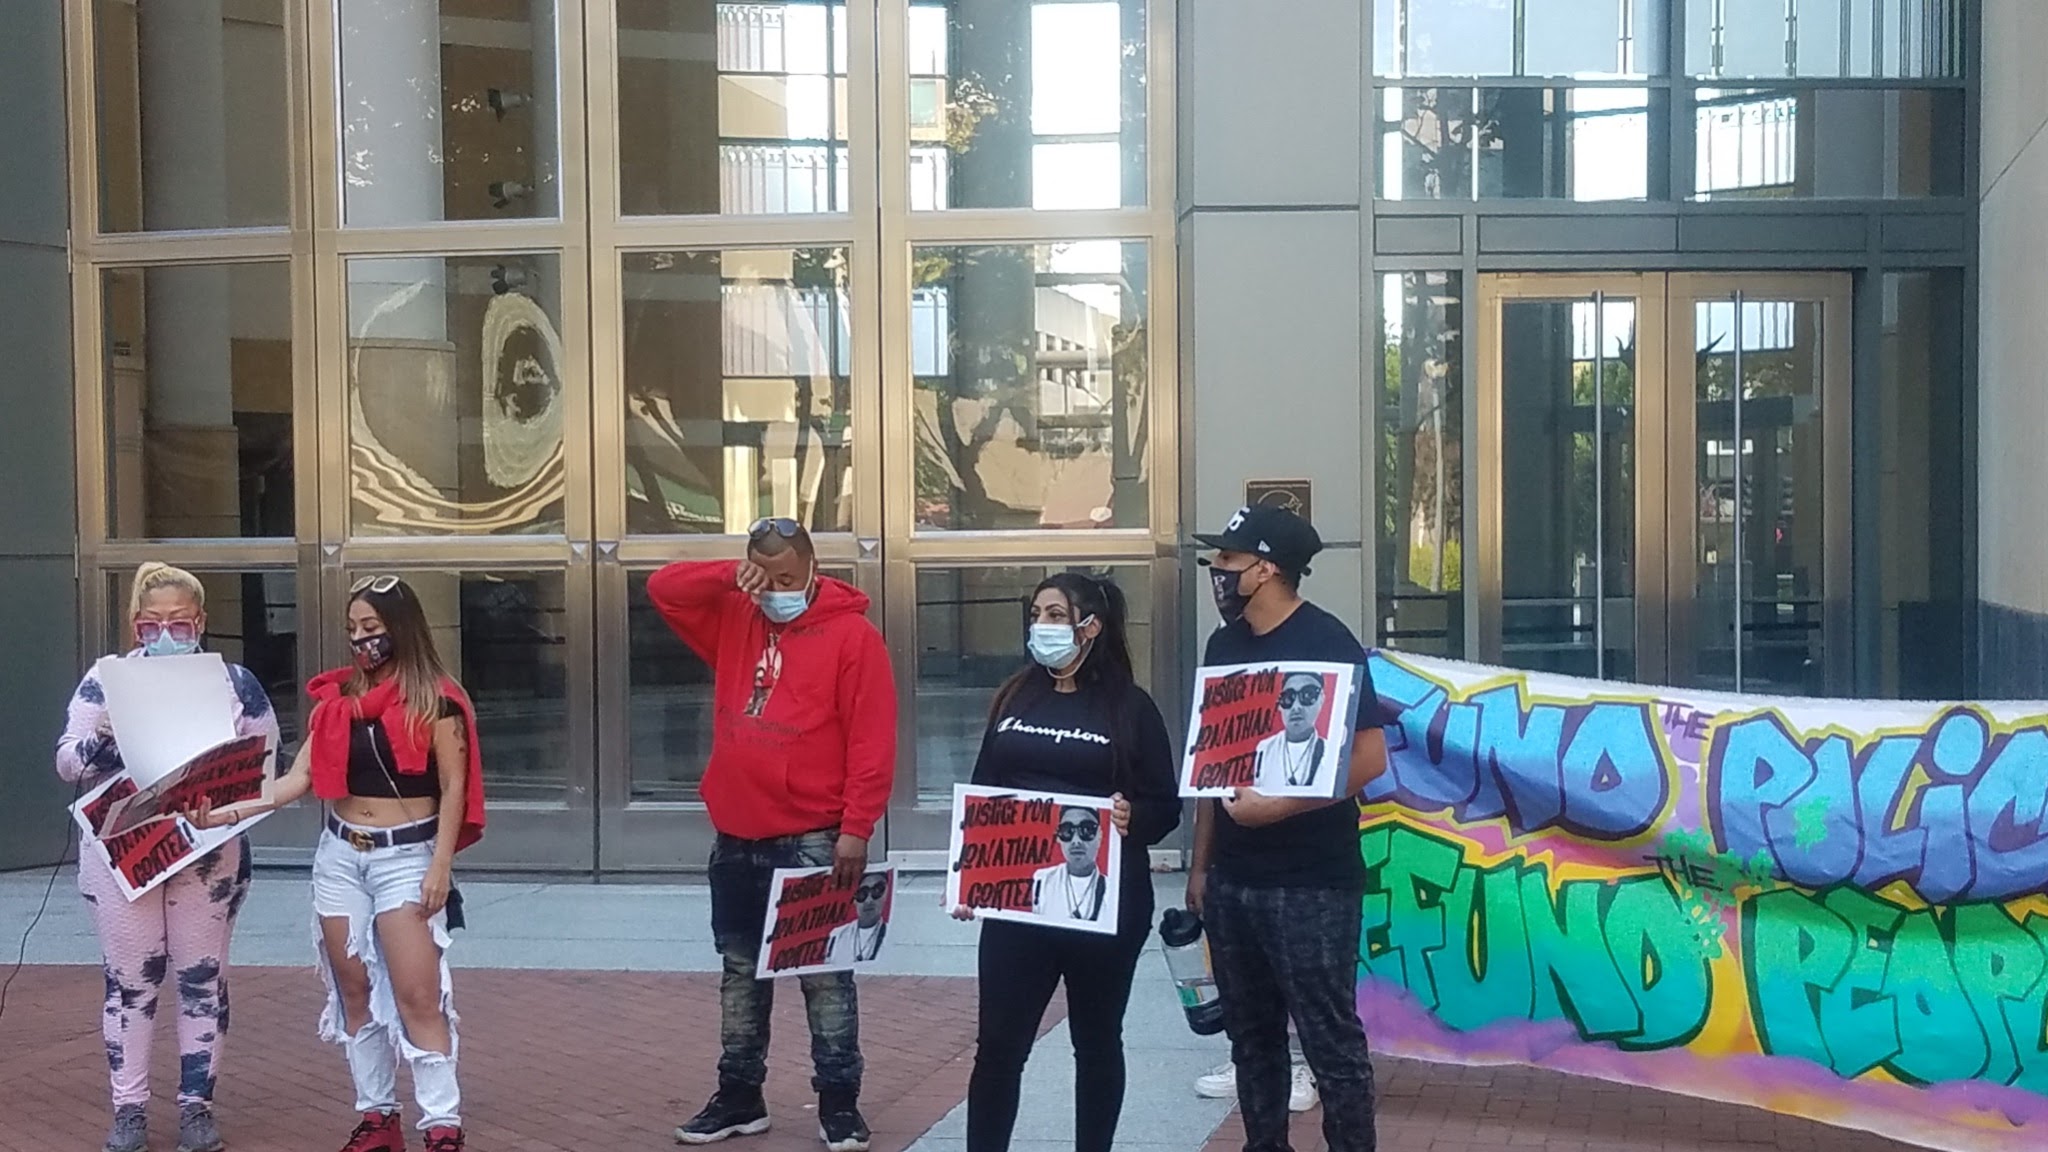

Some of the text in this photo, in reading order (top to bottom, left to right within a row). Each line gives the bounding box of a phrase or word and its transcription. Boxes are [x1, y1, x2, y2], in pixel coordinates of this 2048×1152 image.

[1199, 666, 1279, 714] JUSTICE FOR
[997, 716, 1110, 745] Champion
[1189, 701, 1280, 756] JONATHAN
[1656, 700, 1714, 740] THE
[1196, 751, 1263, 791] CORTEZ!
[960, 794, 1054, 830] JUSTICE FOR
[132, 821, 195, 888] CORTEZ!
[953, 833, 1058, 873] JONATHAN
[1642, 854, 1724, 891] THE
[968, 877, 1042, 912] CORTEZ!
